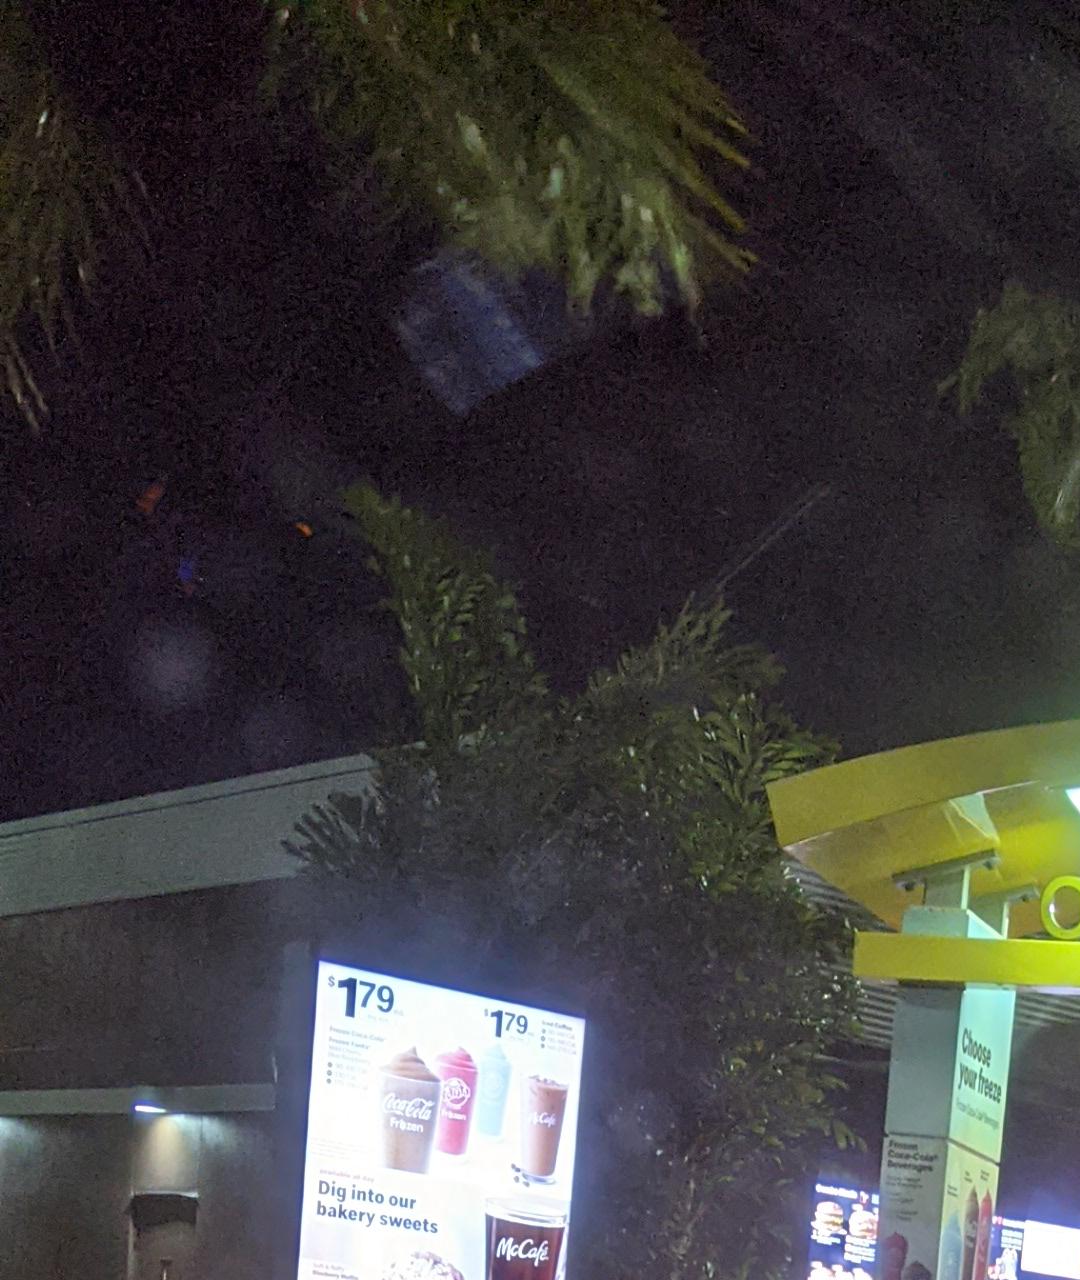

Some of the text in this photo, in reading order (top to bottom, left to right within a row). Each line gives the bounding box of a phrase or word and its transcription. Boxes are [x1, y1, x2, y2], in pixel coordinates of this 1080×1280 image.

[962, 1027, 992, 1068] Choose
[958, 1061, 1002, 1104] your freeze
[390, 1117, 424, 1133] Frozen
[318, 1180, 417, 1209] Dig into our
[316, 1200, 439, 1234] bakery sweets
